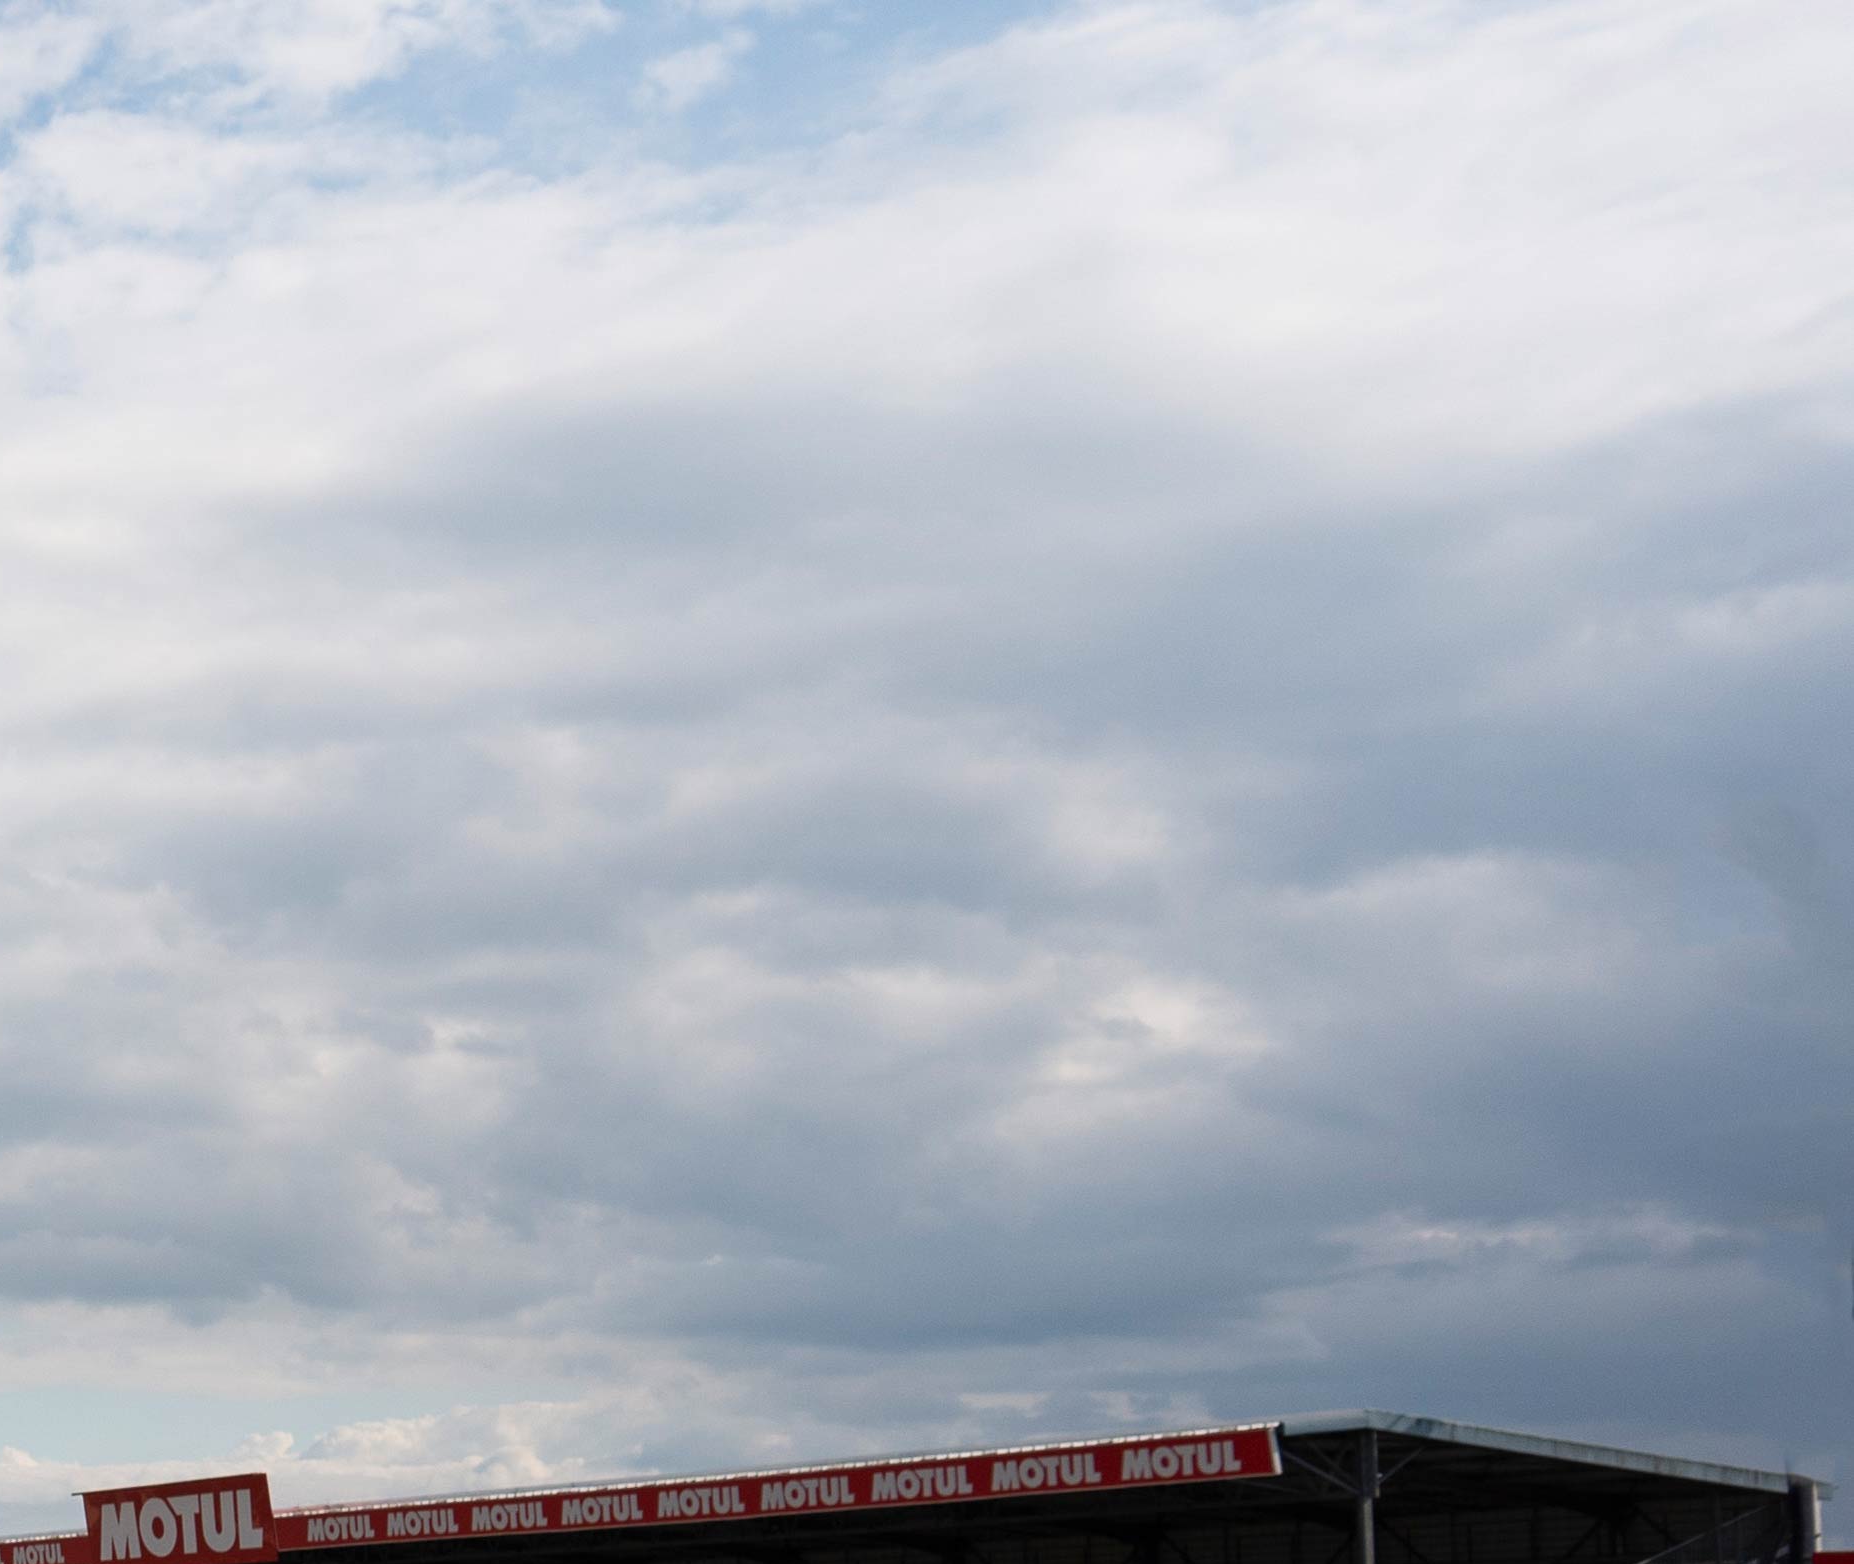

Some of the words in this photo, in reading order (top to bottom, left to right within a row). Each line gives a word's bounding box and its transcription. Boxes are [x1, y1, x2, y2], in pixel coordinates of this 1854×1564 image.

[100, 1488, 264, 1562] MOTUL
[308, 1515, 374, 1541] MOTUL
[387, 1508, 458, 1536] MOTUL
[471, 1502, 547, 1531] MOTUL
[562, 1494, 642, 1526] MOTUL
[658, 1486, 744, 1518] MOTUL
[760, 1474, 855, 1511] MOTUL
[872, 1465, 973, 1501] MOTUL
[992, 1452, 1101, 1491] MOTUL
[1122, 1440, 1242, 1480] MOTUL
